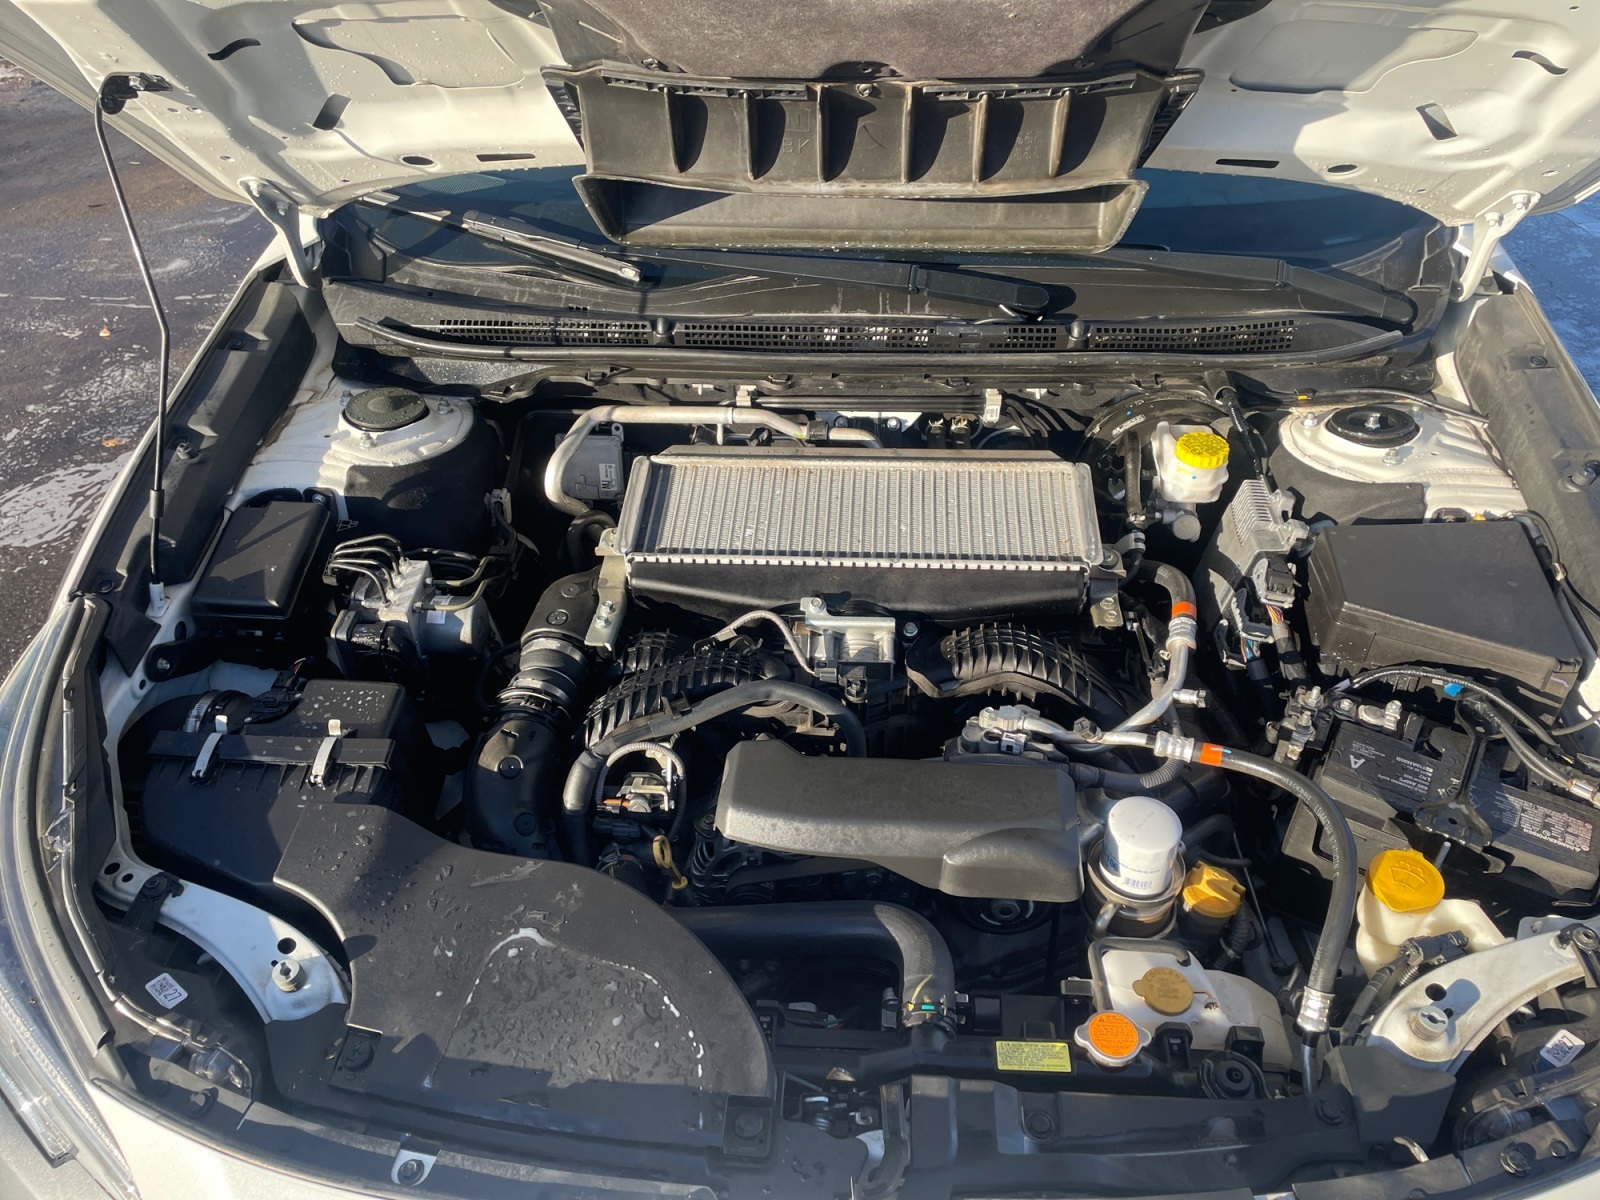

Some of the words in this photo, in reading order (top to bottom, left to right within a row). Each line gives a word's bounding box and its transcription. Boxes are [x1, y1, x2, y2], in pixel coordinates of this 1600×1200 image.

[782, 138, 810, 154] BK
[1350, 755, 1366, 768] A
[164, 988, 182, 1002] 27
[1558, 1035, 1575, 1050] 27
